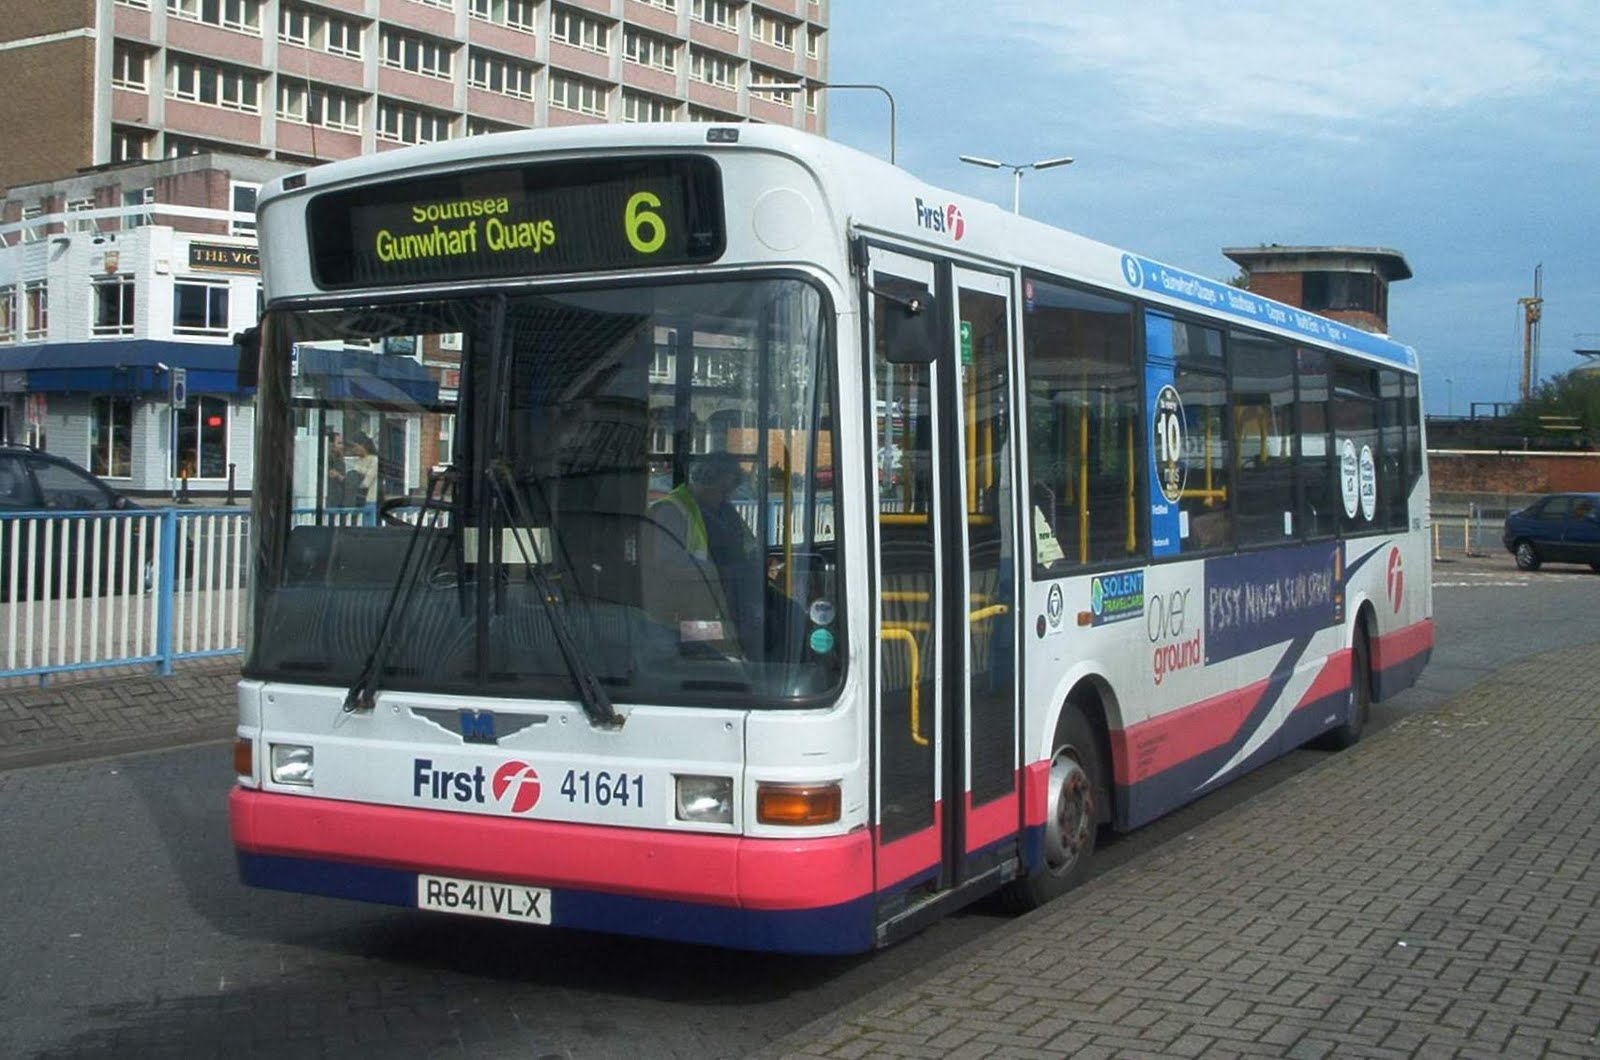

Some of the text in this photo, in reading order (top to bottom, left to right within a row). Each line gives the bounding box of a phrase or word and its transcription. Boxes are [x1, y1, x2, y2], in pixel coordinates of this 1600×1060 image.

[624, 191, 667, 253] 6
[915, 197, 946, 233] First
[193, 248, 228, 263] THE
[376, 218, 556, 262] Gunwharf Quays
[1157, 413, 1181, 462] 10
[1103, 572, 1144, 599] SOLENT
[1244, 579, 1282, 624] NIVEA
[1154, 629, 1201, 686] ground
[413, 758, 485, 803] First
[560, 769, 644, 808] 41641
